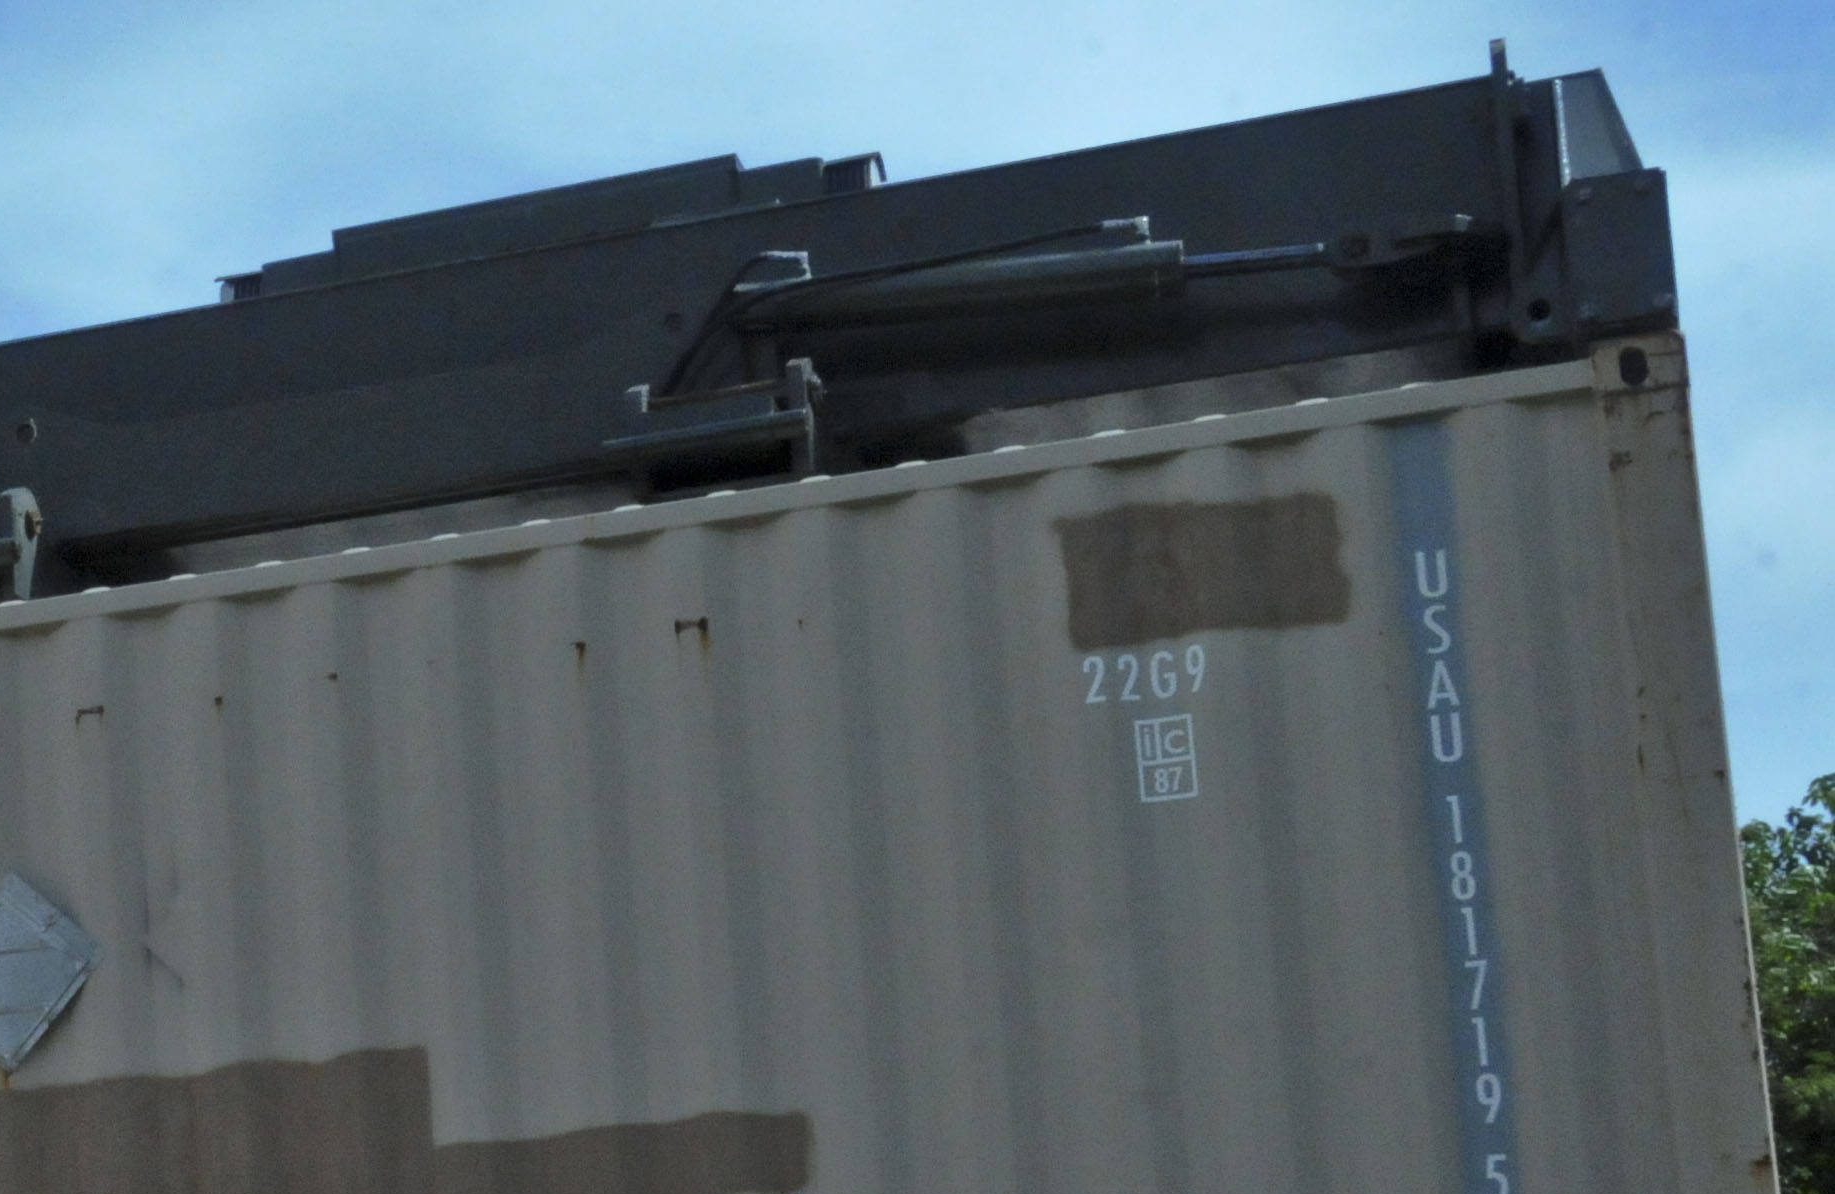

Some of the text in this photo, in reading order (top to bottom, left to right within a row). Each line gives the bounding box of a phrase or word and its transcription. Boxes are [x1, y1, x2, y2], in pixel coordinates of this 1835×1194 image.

[1082, 643, 1206, 705] 22G9
[1153, 766, 1183, 793] 87
[1414, 548, 1464, 764] USAU
[1445, 795, 1502, 1124] 181719
